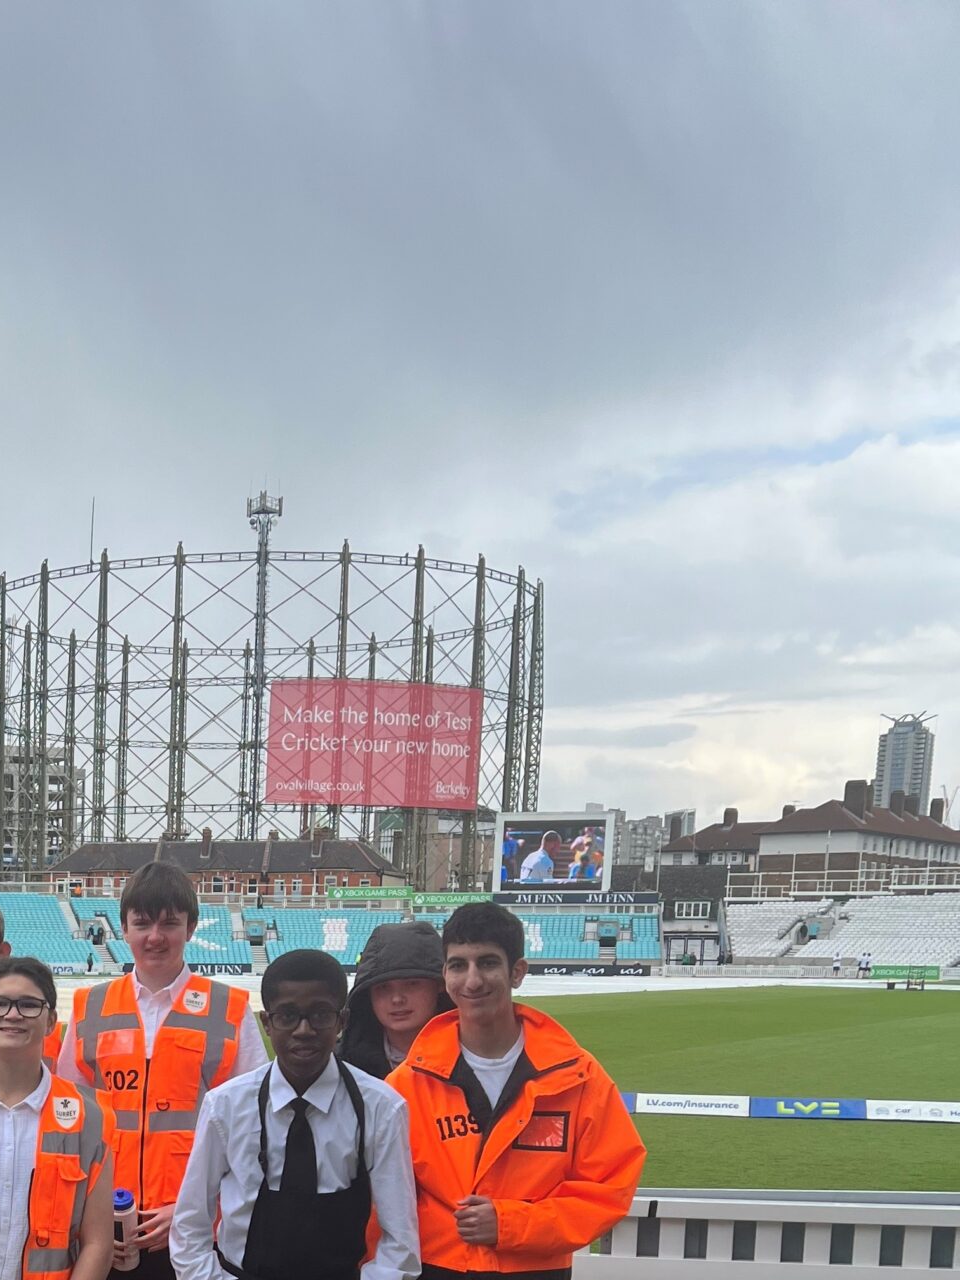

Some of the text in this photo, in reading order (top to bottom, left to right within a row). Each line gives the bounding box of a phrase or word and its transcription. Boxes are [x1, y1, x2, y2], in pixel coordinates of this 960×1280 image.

[283, 706, 473, 731] Make the home of Test
[281, 733, 471, 758] Cricket your new home
[276, 779, 365, 793] ovalvillage.co.uk
[435, 780, 471, 800] Berkeley
[344, 889, 365, 897] XBOX
[365, 889, 386, 897] GAME
[425, 895, 447, 903] XBOX
[447, 895, 469, 903] GAME
[515, 894, 564, 903] JM FINN
[586, 894, 635, 903] JM FINN
[214, 965, 242, 975] FINN
[646, 1099, 740, 1109] LV.com/insurance
